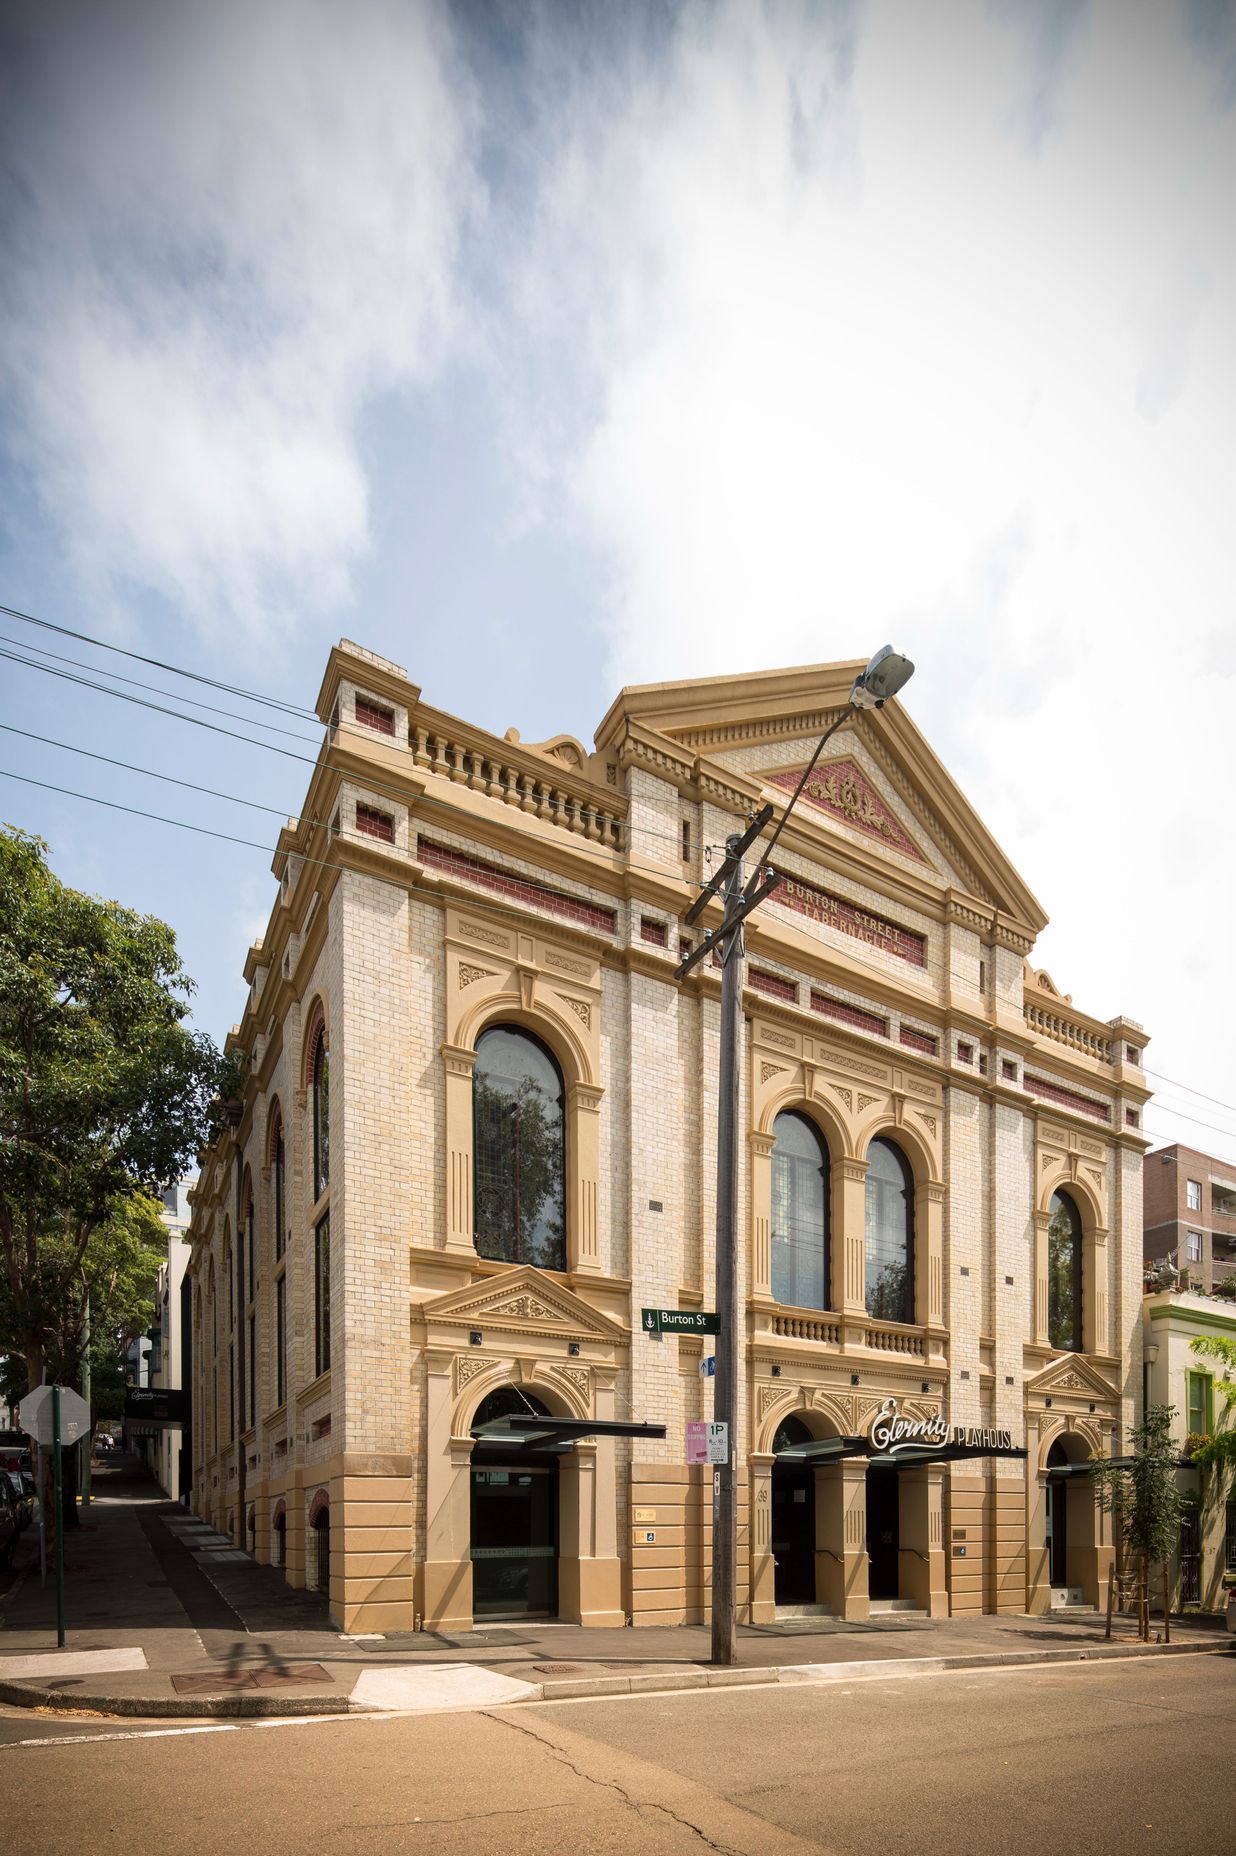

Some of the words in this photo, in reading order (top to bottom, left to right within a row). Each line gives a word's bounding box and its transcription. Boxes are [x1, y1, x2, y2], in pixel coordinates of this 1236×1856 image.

[786, 882, 838, 913] BURTON
[854, 911, 901, 942] STREET
[802, 903, 888, 950] TABERNACLE
[661, 1312, 694, 1325] Burton
[696, 1314, 707, 1326] St
[711, 1425, 724, 1435] 1P
[871, 1397, 950, 1454] Eternity
